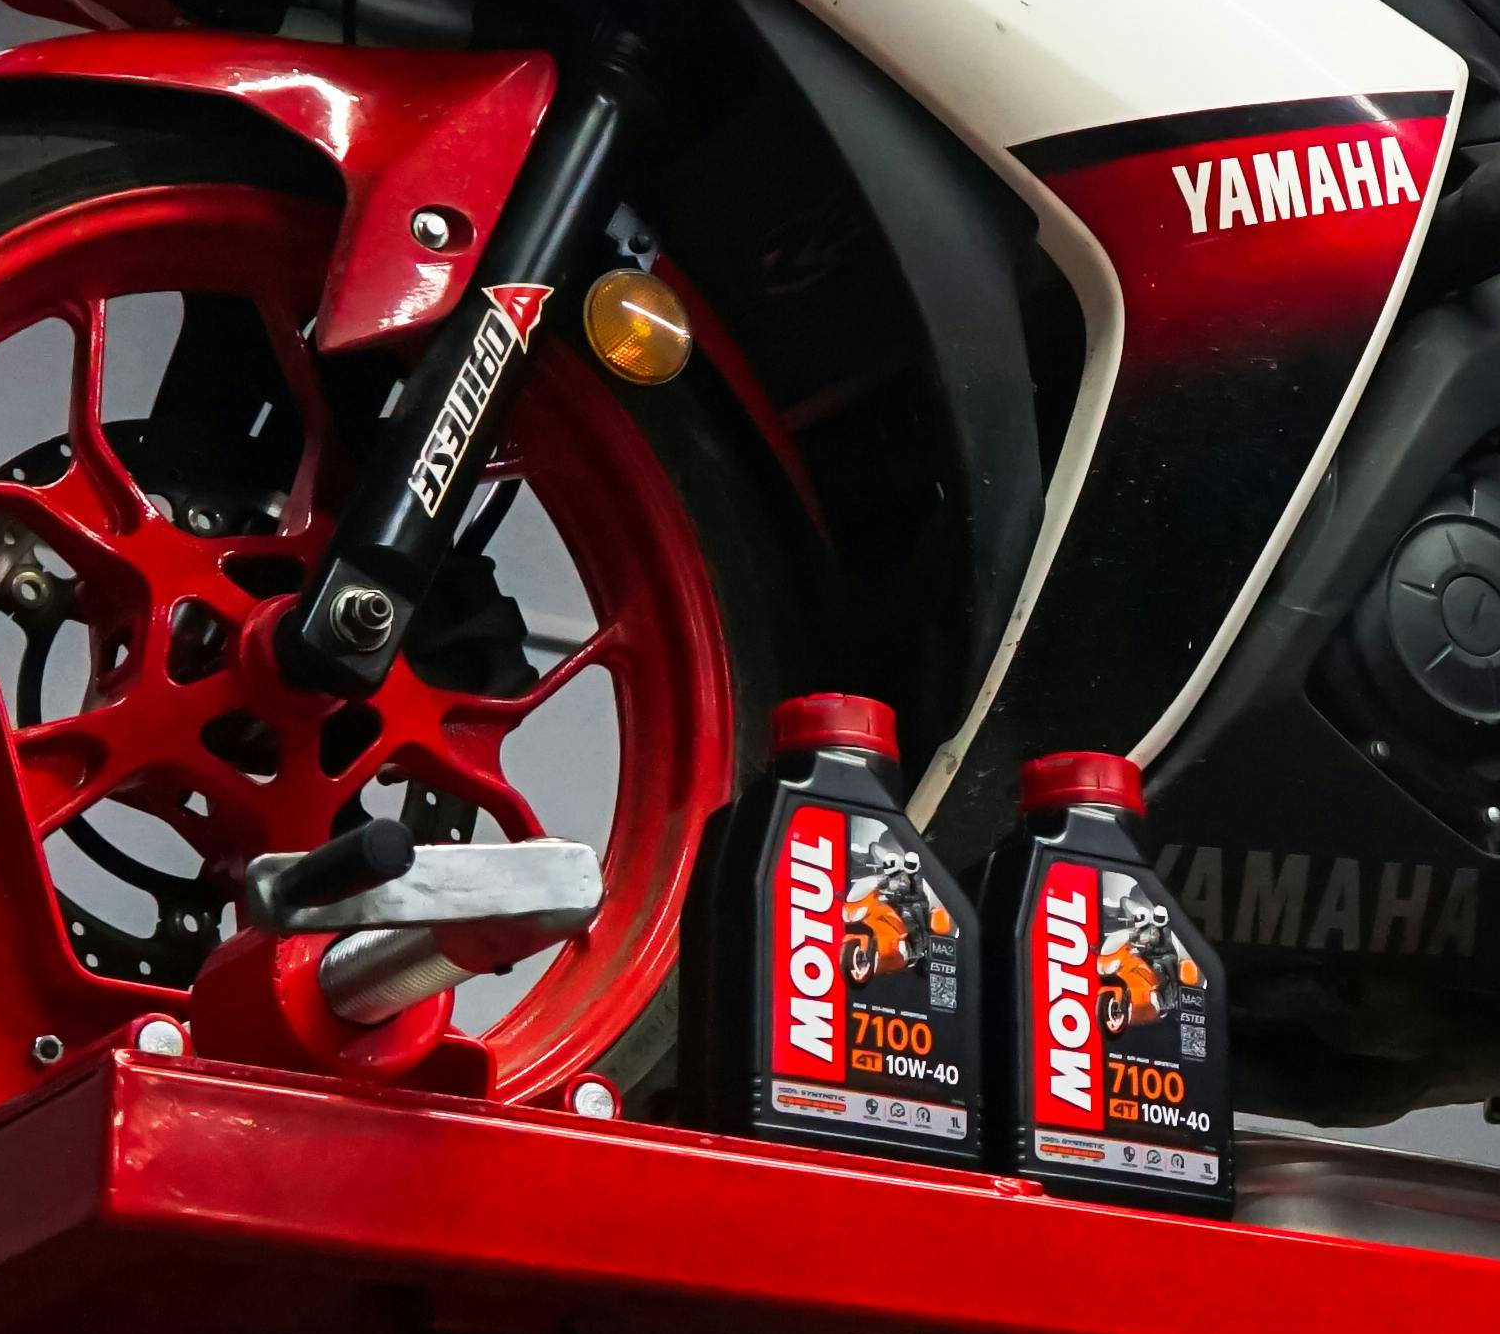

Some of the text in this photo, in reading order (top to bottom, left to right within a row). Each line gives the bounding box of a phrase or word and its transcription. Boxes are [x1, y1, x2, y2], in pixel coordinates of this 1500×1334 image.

[1171, 135, 1421, 235] YAMAHA
[407, 308, 518, 520] DAINESE
[789, 835, 835, 1063] MOTUL
[932, 942, 954, 955] MA2
[930, 962, 957, 974] ESTER
[1046, 890, 1092, 1112] MOTUL
[1181, 993, 1203, 1007] MA2
[851, 1011, 933, 1056] 7100
[1180, 1012, 1206, 1024] ESTER
[855, 1053, 960, 1085] 4T 10W-40
[1107, 1061, 1185, 1103] 7100
[950, 1116, 961, 1129] 1L
[1112, 1102, 1211, 1132] 4T 10W-40
